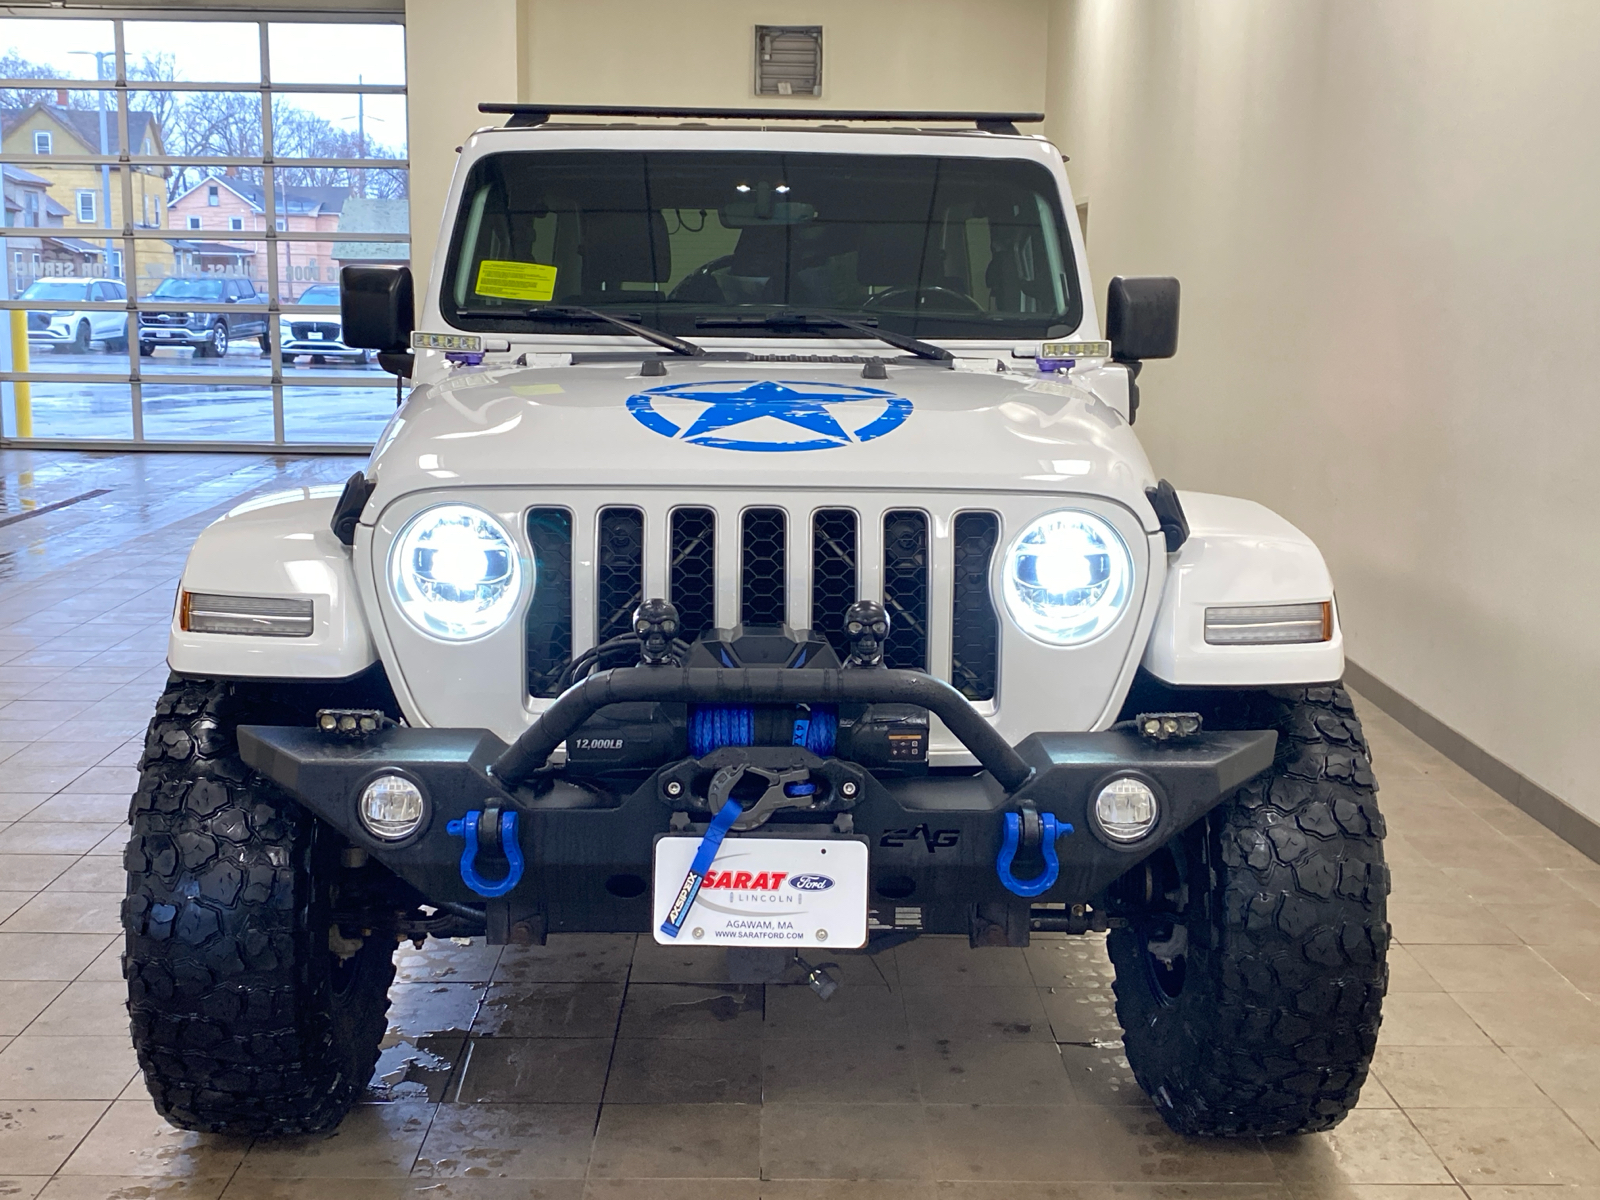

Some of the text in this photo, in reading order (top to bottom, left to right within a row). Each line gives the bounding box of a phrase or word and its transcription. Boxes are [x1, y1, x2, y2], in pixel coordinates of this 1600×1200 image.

[575, 738, 623, 750] 12,000LB
[702, 870, 827, 891] SARAT Ford
[738, 894, 794, 903] LINCOLN
[726, 920, 794, 930] AGAWAM, MA
[715, 931, 804, 940] WWW.SARATFORD.COM
